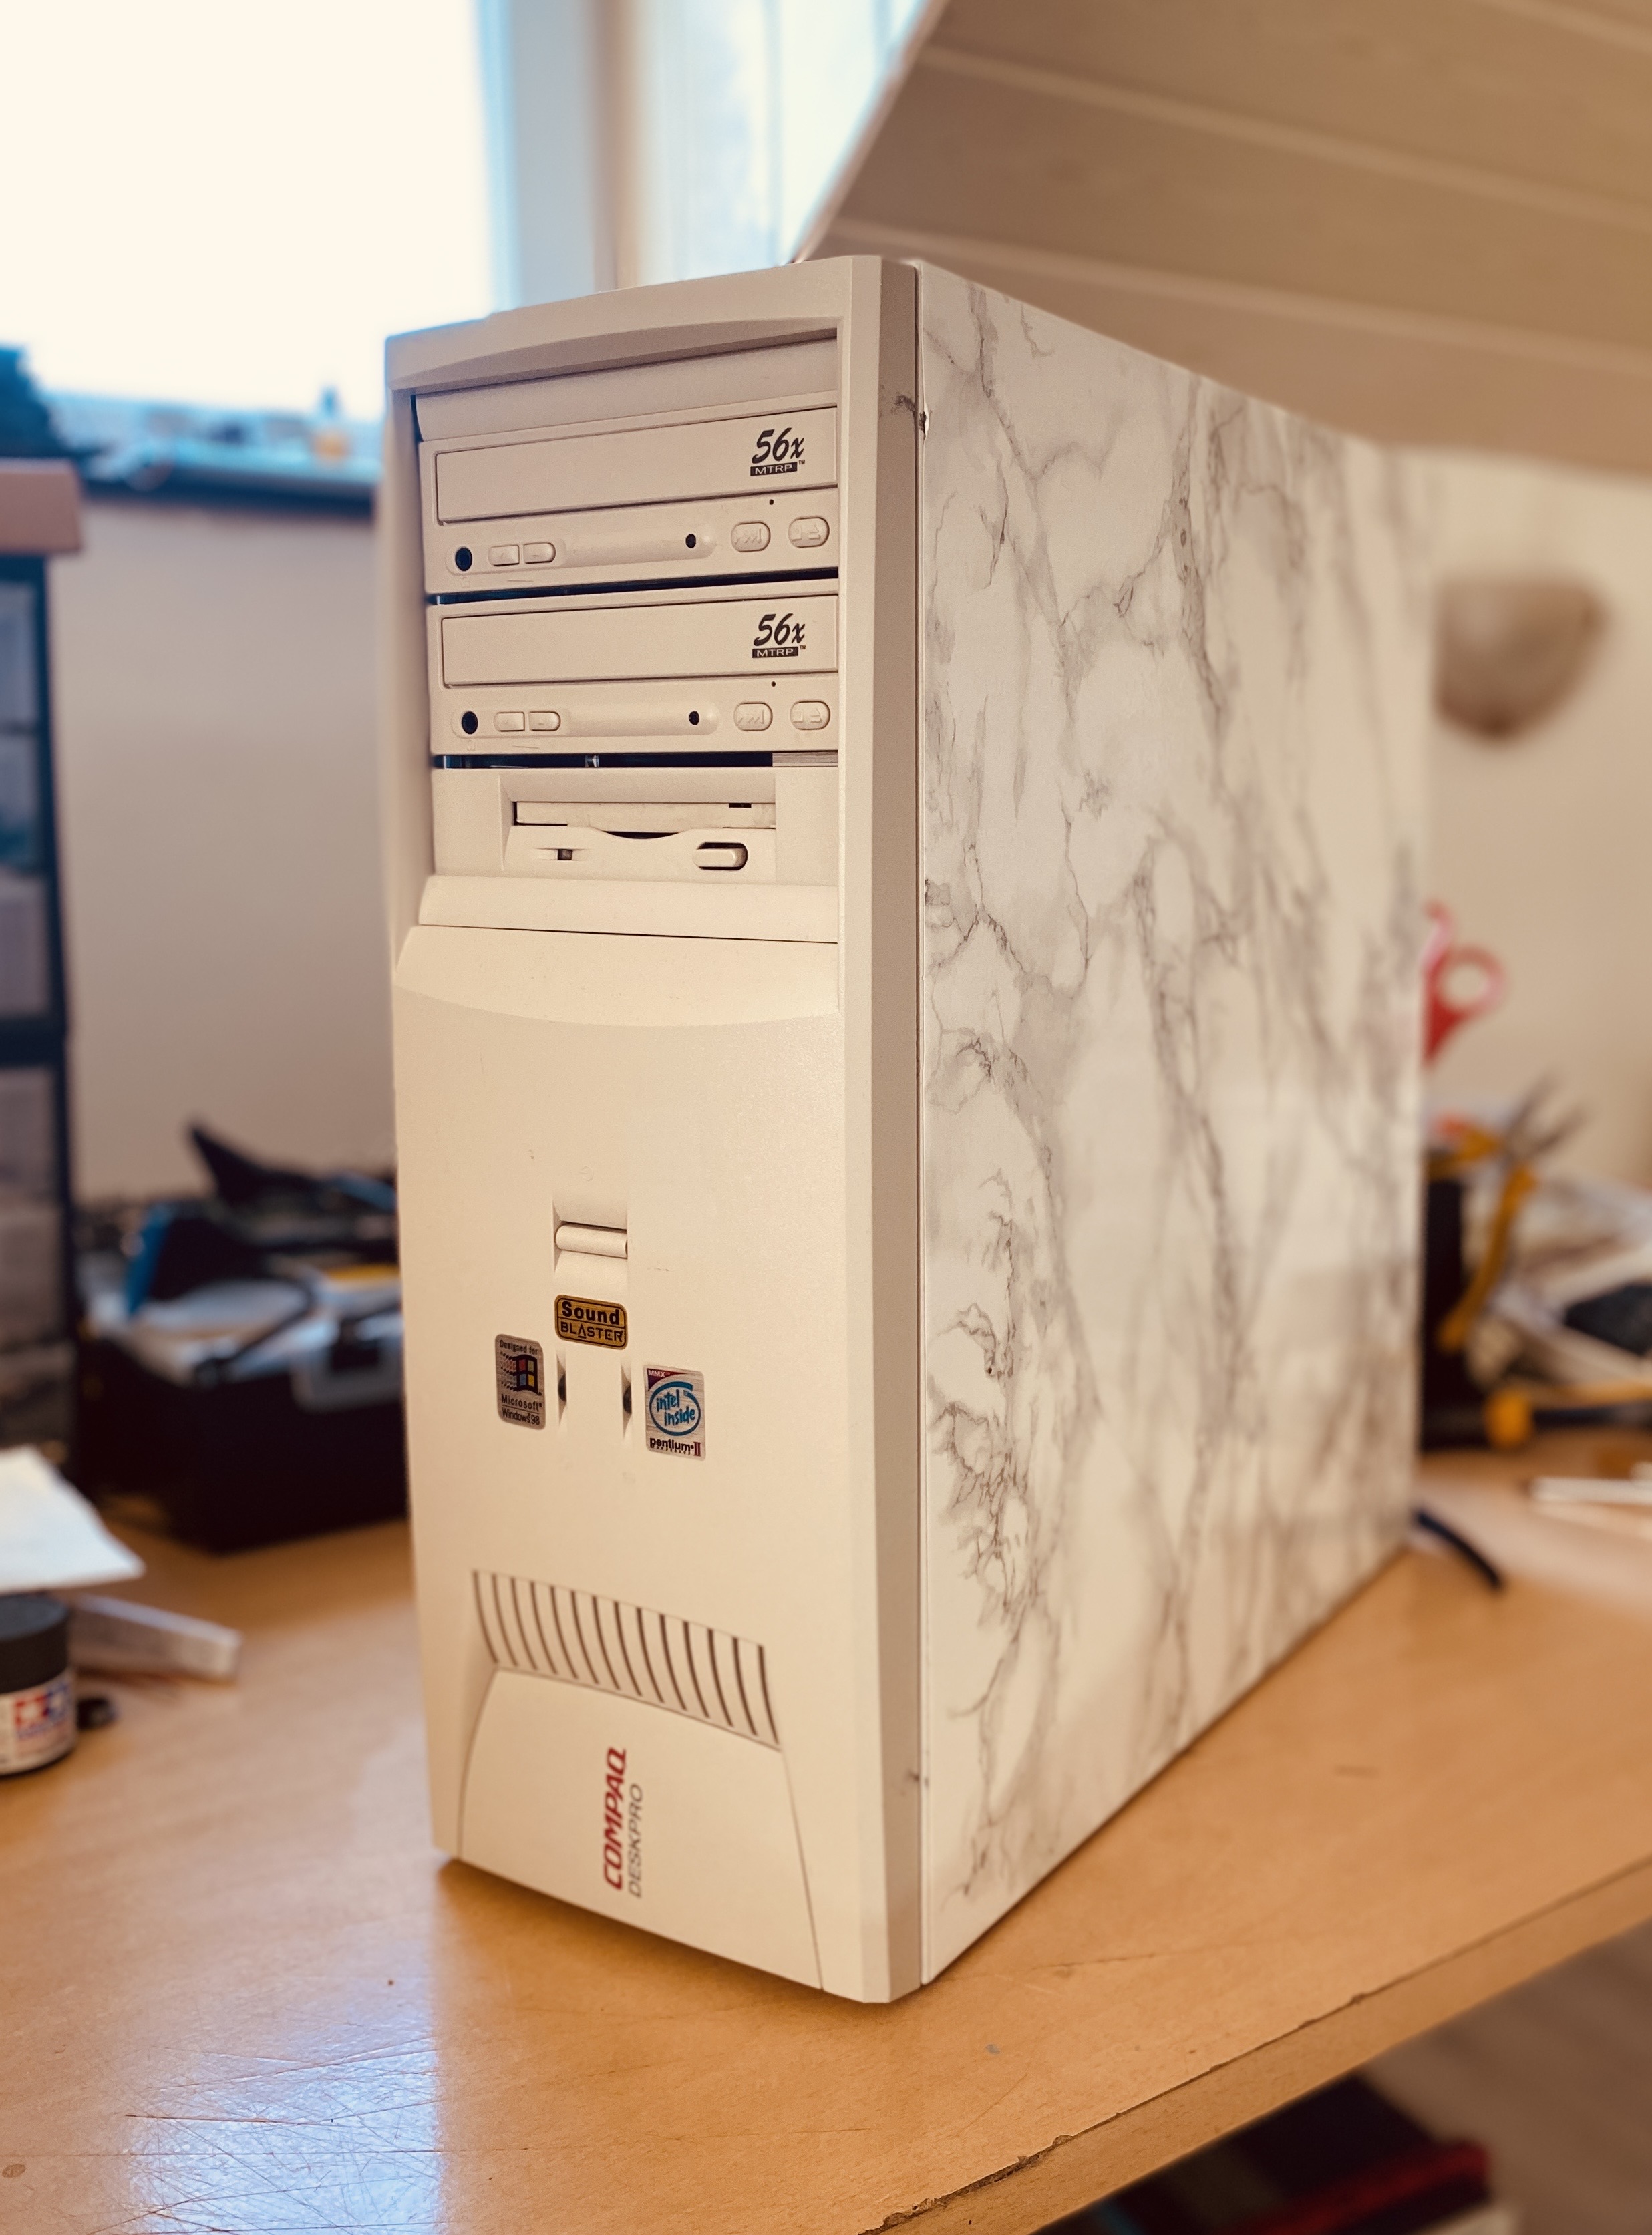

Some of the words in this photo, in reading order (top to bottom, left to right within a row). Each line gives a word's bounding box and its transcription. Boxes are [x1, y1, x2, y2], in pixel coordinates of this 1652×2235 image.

[752, 427, 804, 464] 56x
[755, 464, 792, 475] MTRP
[753, 613, 806, 646] 56x
[756, 648, 794, 657] MTRP
[562, 1301, 620, 1325] Sound
[560, 1321, 623, 1343] BLASTER
[500, 1339, 527, 1353] Designed
[501, 1393, 539, 1412] Microsoft
[656, 1389, 679, 1413] intel
[664, 1405, 695, 1426] inside
[604, 1746, 626, 1890] COMPAQ
[628, 1782, 643, 1898] DESKPRO
